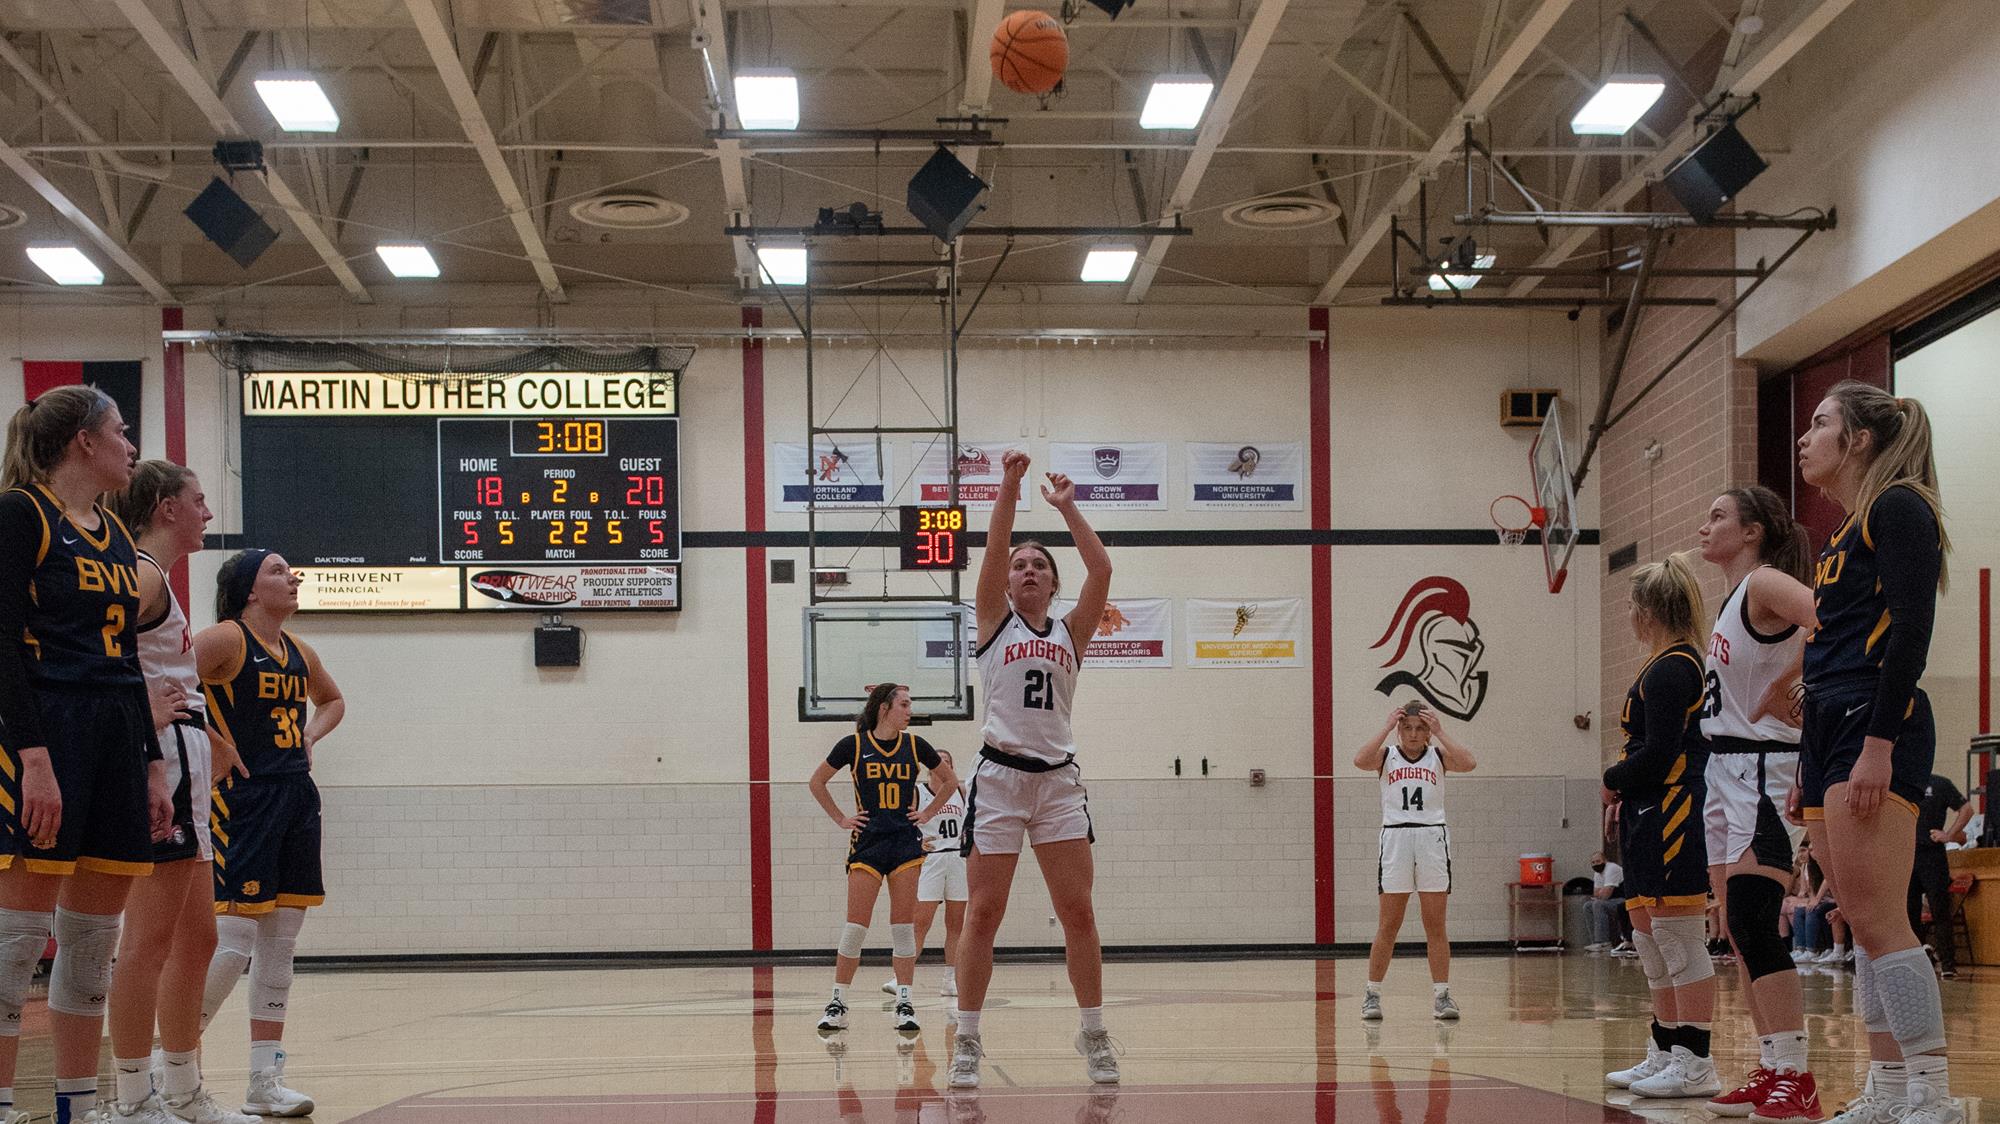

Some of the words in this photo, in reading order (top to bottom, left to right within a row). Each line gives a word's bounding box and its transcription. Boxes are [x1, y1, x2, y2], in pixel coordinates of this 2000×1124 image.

[251, 379, 371, 410] MARTIN
[382, 379, 507, 410] LUTHER
[518, 378, 667, 410] COLLEGE
[537, 422, 602, 452] 3:08
[460, 458, 498, 472] HOME
[620, 458, 662, 472] GUEST
[544, 469, 576, 479] PERIOD
[477, 476, 503, 506] 18
[522, 492, 531, 503] B
[552, 480, 568, 503] 2
[590, 492, 599, 503] B
[626, 476, 664, 506] 20
[813, 486, 858, 494] ORTHLAND
[815, 493, 852, 501] COLLEGE
[958, 492, 989, 500] OLLEGE
[453, 510, 482, 520] FOULS
[494, 510, 520, 520] T.O.L.
[531, 510, 565, 520] PLAYER
[570, 510, 593, 519] FOUL
[604, 510, 630, 519] T.O.L.
[639, 510, 667, 519] FOULS
[919, 510, 962, 530] 3:08
[463, 521, 479, 545] 5
[499, 521, 514, 545] 5
[607, 521, 623, 545] 5
[649, 520, 664, 544] 5
[454, 550, 483, 560] SCORE
[545, 549, 576, 559] MATCH
[640, 548, 669, 558] SCORE
[916, 531, 954, 564] 30
[74, 556, 140, 599] BVU
[314, 572, 404, 582] THRIVENT
[580, 568, 627, 576] PROMOTIONAL
[477, 575, 578, 590] PRINTWEAR
[583, 578, 625, 587] PROUDLY
[626, 577, 673, 586] SUPPORTS
[318, 586, 382, 594] FINANCIAL
[522, 591, 577, 601] GRAPHICS
[593, 588, 612, 597] MLC
[614, 587, 663, 597] ATHLETICS
[101, 603, 126, 658] 2
[1003, 639, 1073, 675] KNIGHTS
[257, 671, 308, 703] BVU
[1023, 669, 1054, 710] 21
[270, 706, 302, 749] 31
[866, 762, 910, 780] BVU
[1387, 766, 1437, 786] KNIGHTS
[878, 782, 900, 810] 10
[1401, 786, 1424, 811] 14
[938, 819, 959, 839] 40
